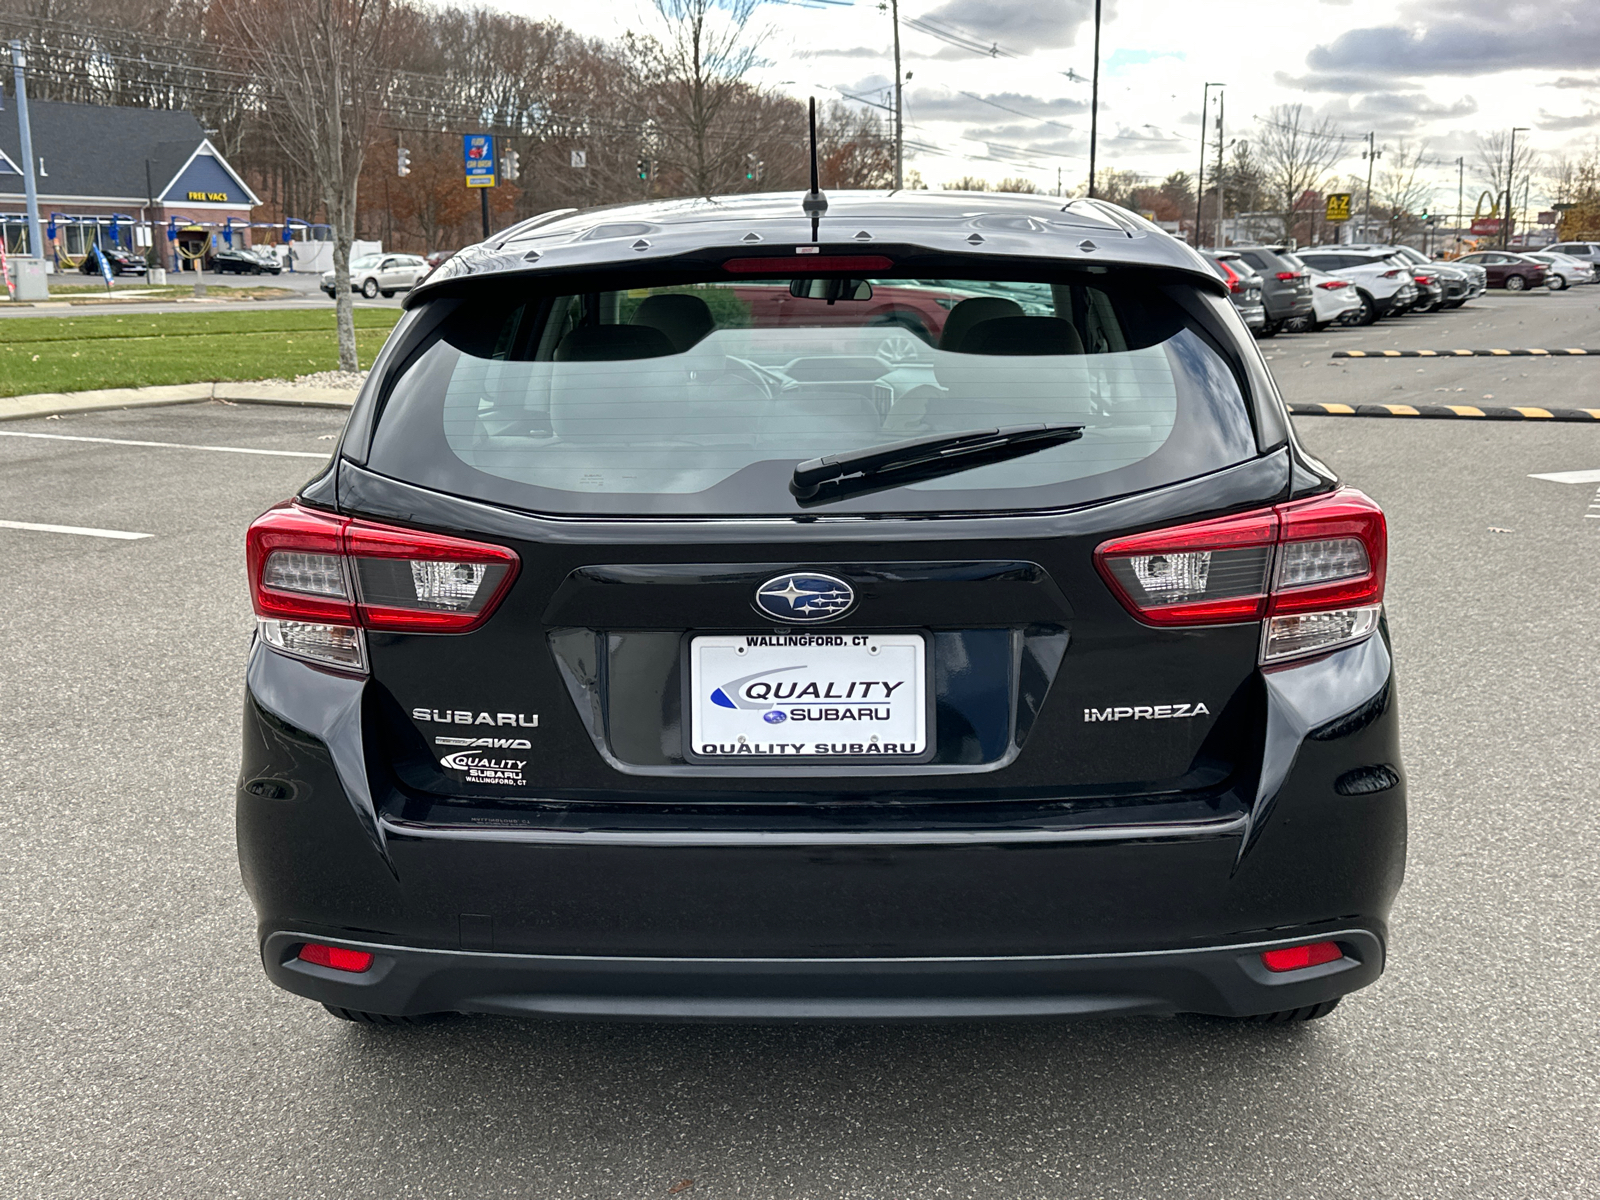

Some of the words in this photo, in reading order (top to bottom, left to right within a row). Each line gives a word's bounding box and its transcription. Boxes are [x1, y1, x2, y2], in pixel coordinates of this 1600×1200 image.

[188, 191, 206, 201] FREE
[207, 192, 228, 202] VACS
[746, 636, 848, 647] WALLINGFORD,
[852, 636, 869, 646] CT
[745, 681, 905, 700] QUALITY
[412, 707, 539, 728] SUBARU
[790, 708, 891, 721] SUBARU
[1083, 702, 1210, 722] IMPREZA
[470, 737, 532, 749] AWD
[702, 743, 805, 754] QUALITY
[814, 742, 916, 754] SUBARU
[455, 756, 527, 769] QUALITY
[469, 769, 522, 779] SUBARU
[465, 776, 516, 786] WALLINGFORD,
